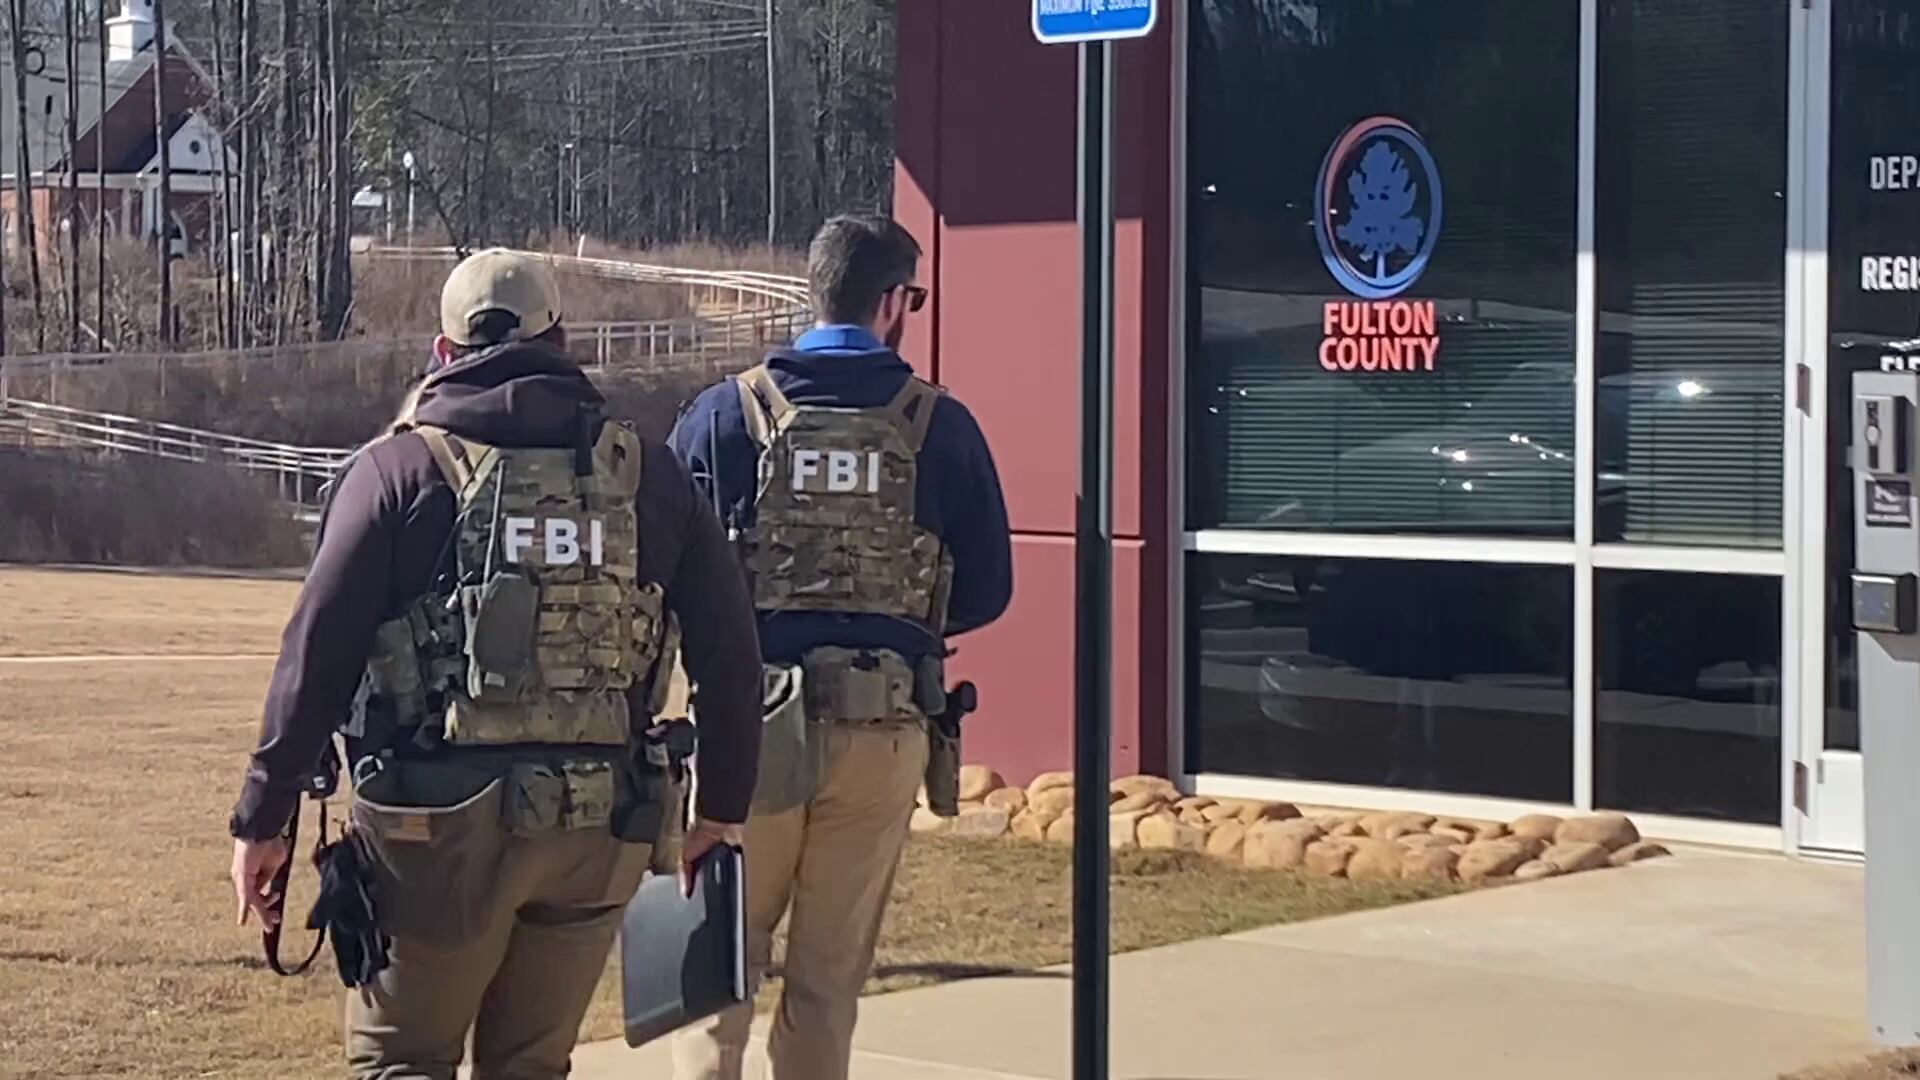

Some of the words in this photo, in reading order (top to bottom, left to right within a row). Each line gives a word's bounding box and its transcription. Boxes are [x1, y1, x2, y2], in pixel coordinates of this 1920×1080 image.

[1870, 156, 1920, 190] DEP
[1861, 255, 1920, 291] REGI
[1323, 302, 1435, 336] FULTON
[1319, 335, 1439, 371] COUNTY
[793, 450, 880, 493] FBI
[505, 517, 604, 566] FBI
